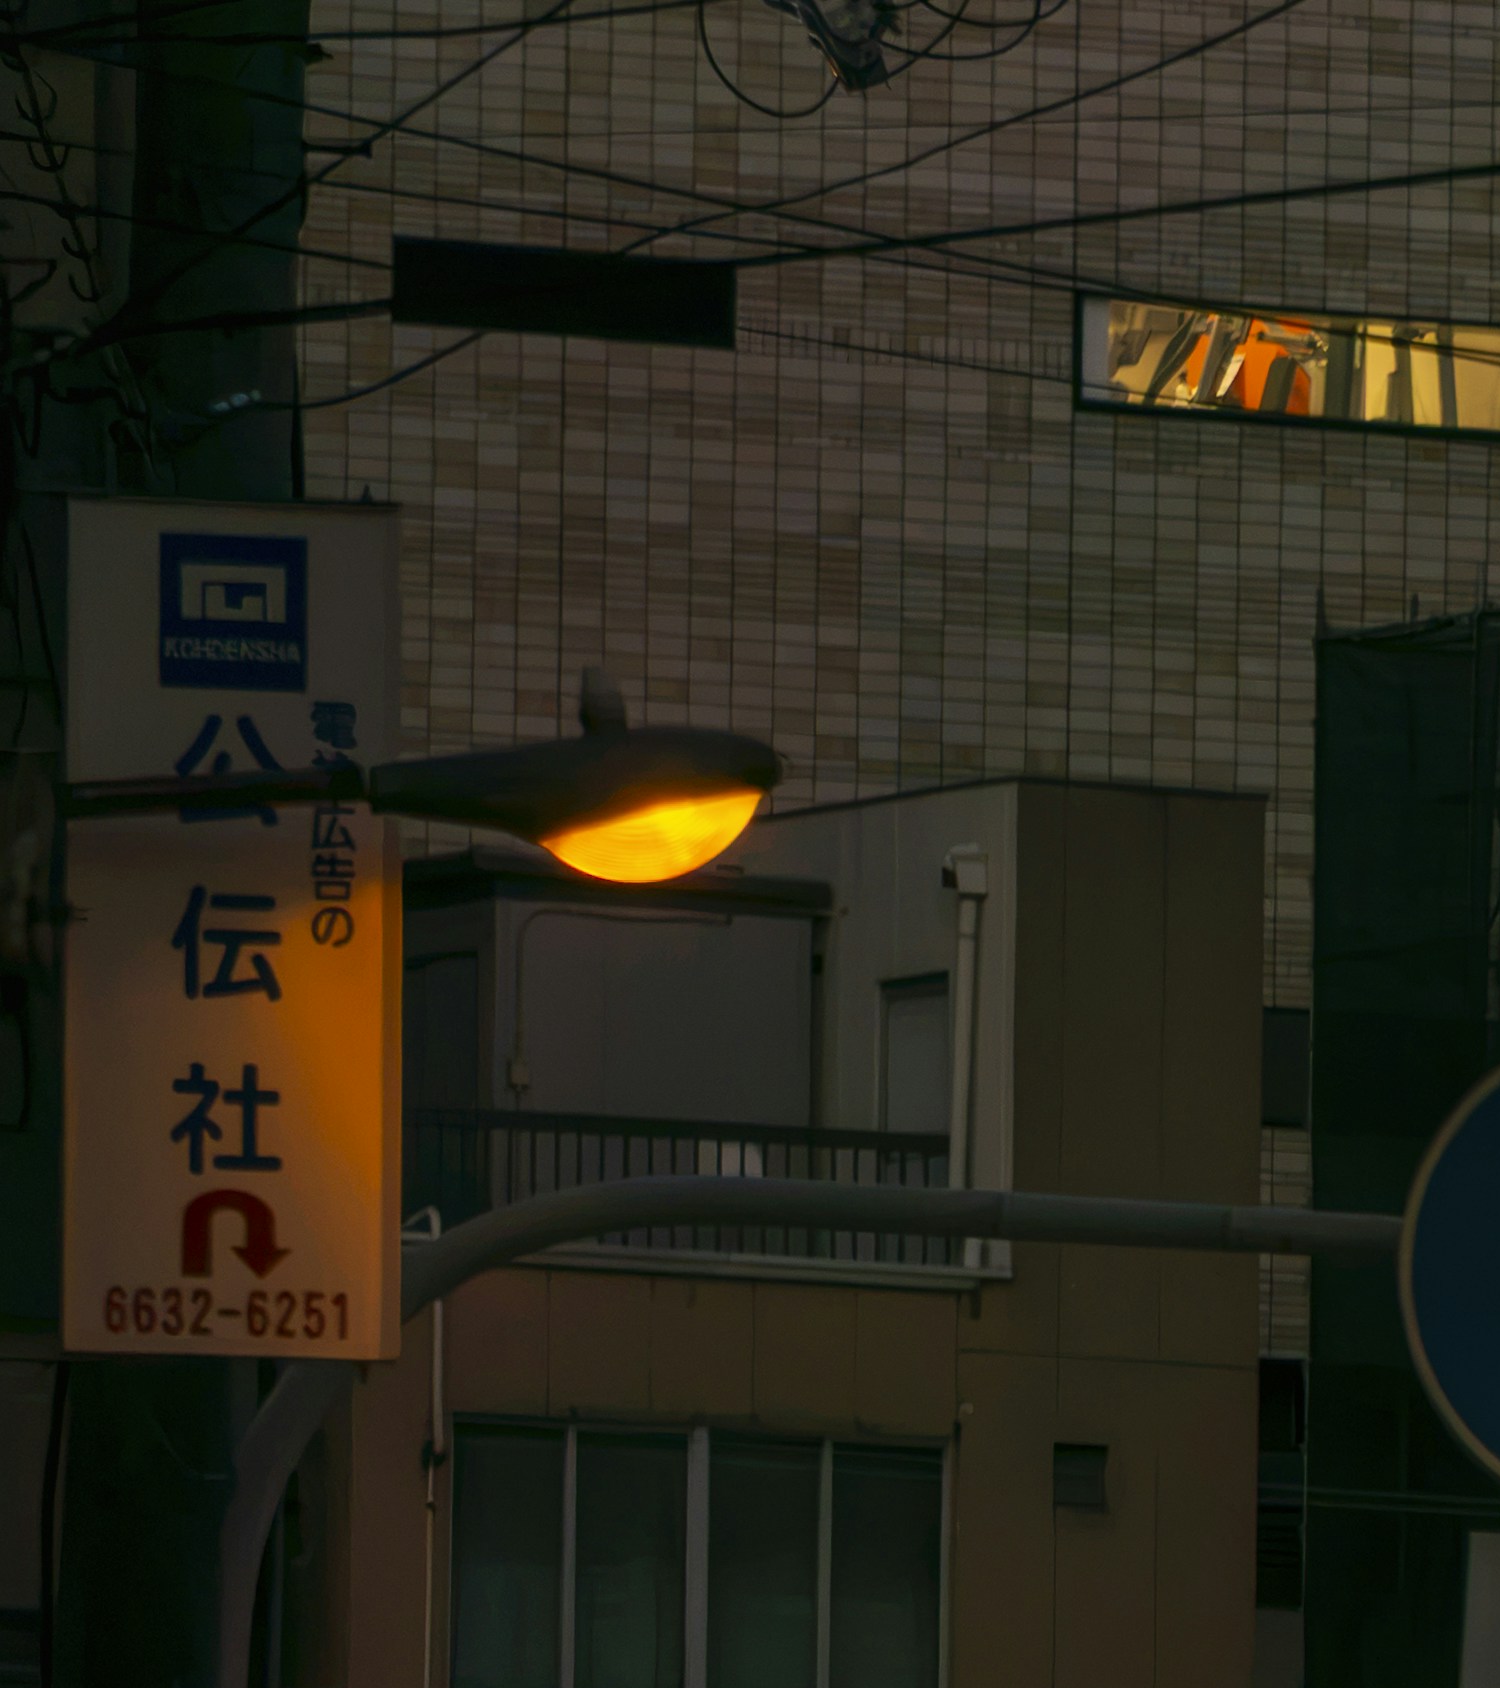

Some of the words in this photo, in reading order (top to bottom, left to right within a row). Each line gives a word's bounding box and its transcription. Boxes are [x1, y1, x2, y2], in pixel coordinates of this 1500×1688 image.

[170, 714, 286, 1176] 公伝社
[104, 1285, 350, 1341] 6632-6251
